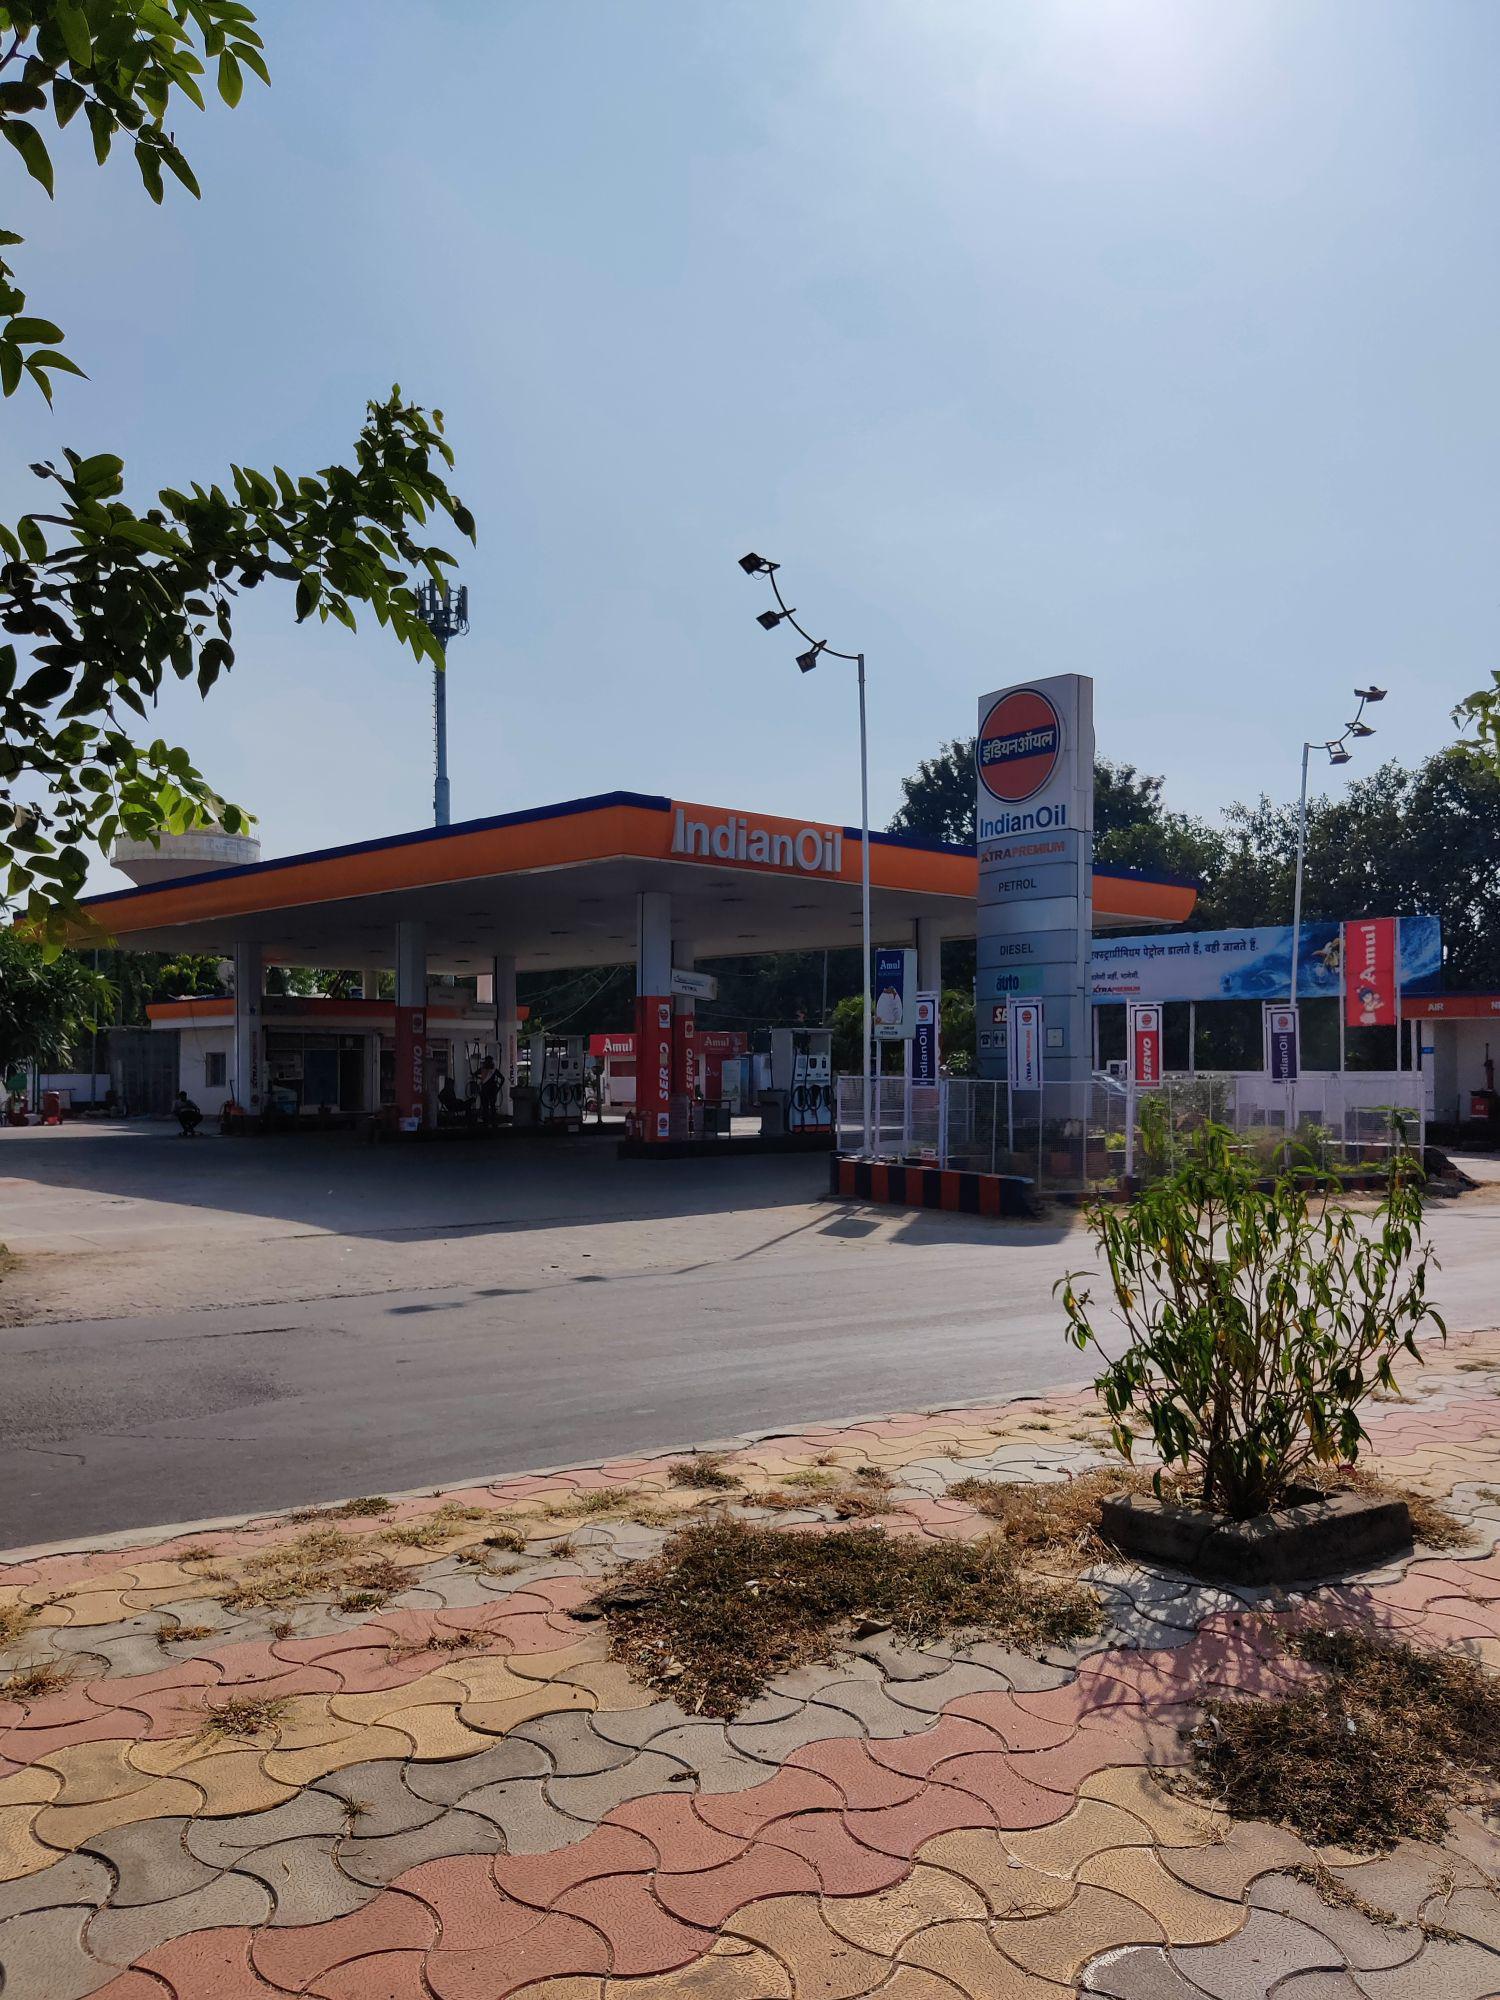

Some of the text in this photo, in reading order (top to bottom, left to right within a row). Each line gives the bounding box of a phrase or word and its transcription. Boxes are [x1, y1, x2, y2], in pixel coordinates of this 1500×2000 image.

[982, 730, 1054, 764] इंडियनऑयल
[980, 804, 1066, 838] IndianOil
[671, 808, 841, 873] IndianOil
[998, 878, 1037, 893] PETROL
[880, 959, 901, 971] Amul
[999, 943, 1035, 956] DIESEL
[1360, 925, 1377, 985] Amul
[1427, 1002, 1444, 1012] AIR
[603, 1038, 633, 1052] Amul
[704, 1036, 730, 1047] Amul
[1280, 1035, 1288, 1079] ndianOil
[412, 1047, 423, 1094] SERVO
[659, 1042, 669, 1101] SERO
[686, 1048, 694, 1090] SERVO
[1143, 1037, 1152, 1081] SERVO
